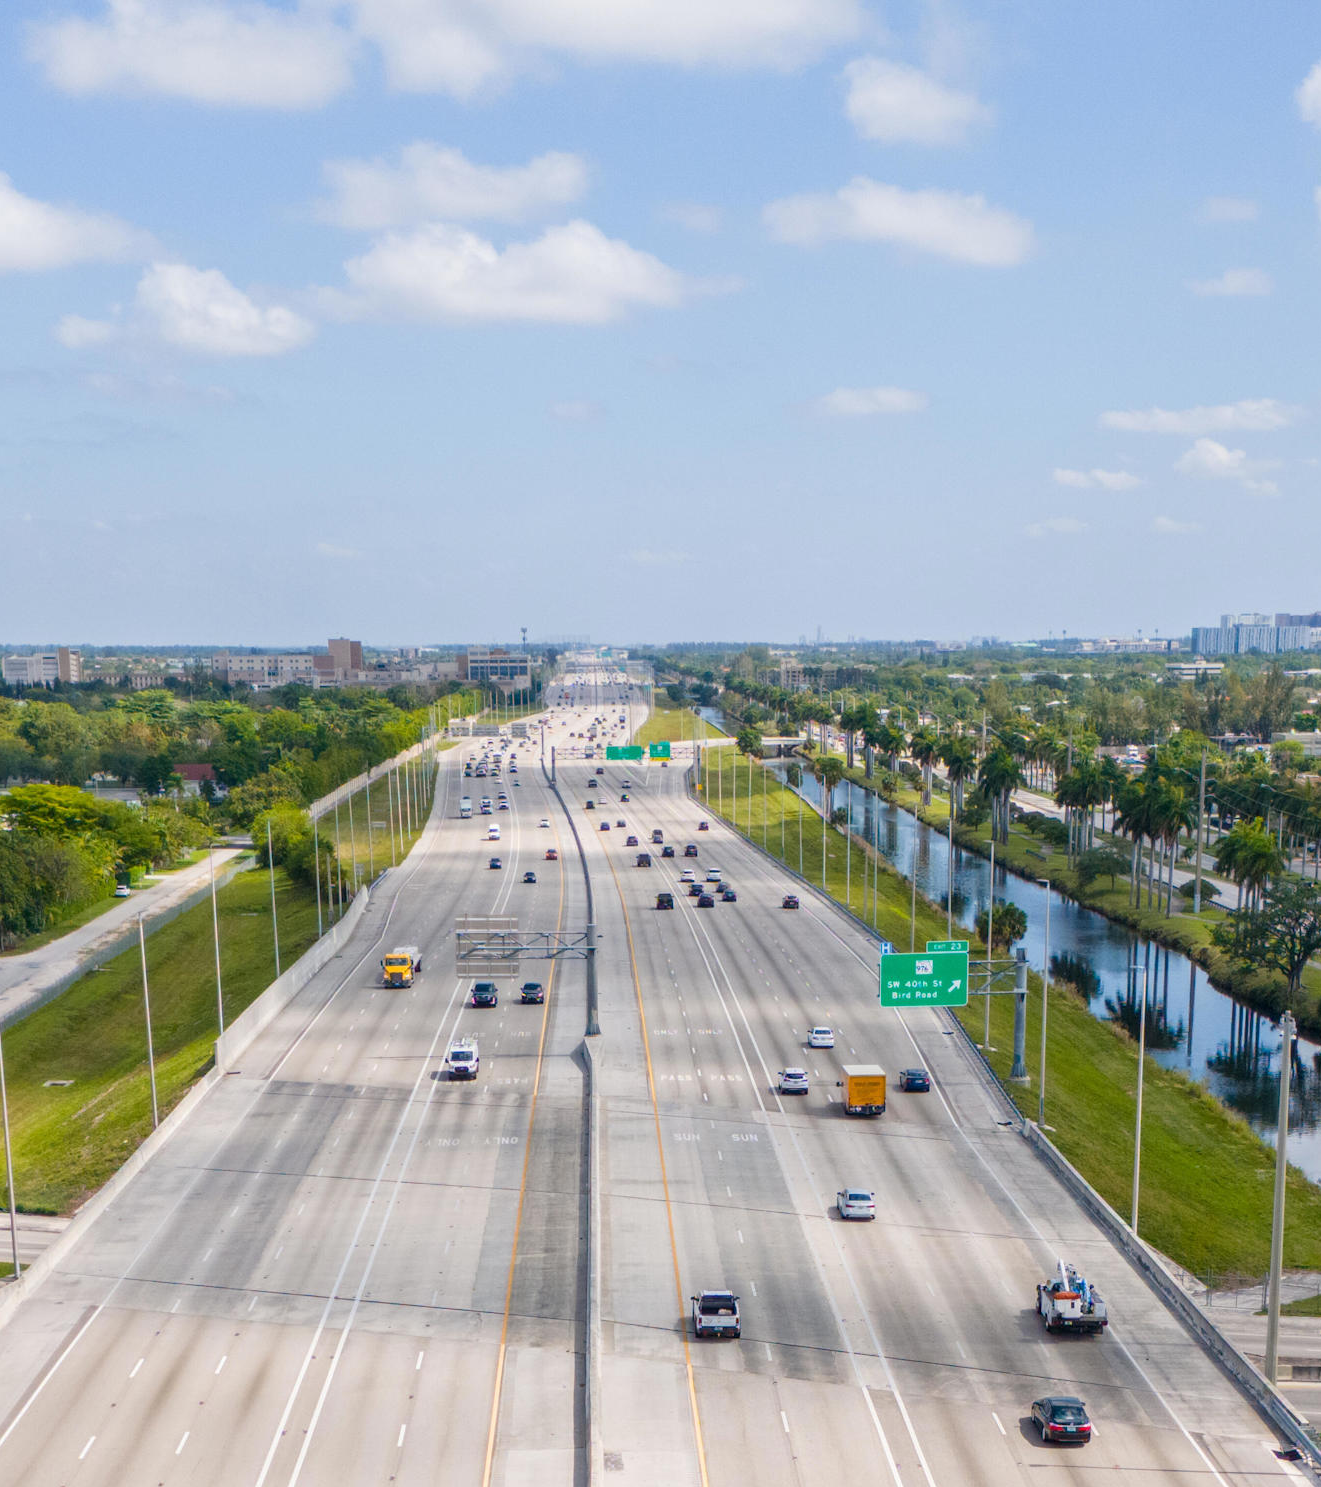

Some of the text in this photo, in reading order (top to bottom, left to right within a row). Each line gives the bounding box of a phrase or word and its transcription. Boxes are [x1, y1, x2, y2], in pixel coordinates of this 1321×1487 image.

[887, 980, 900, 988] SW
[904, 980, 928, 988] 40th
[891, 991, 938, 999] Bird Road
[673, 1133, 700, 1141] SUN
[731, 1133, 759, 1142] SUN
